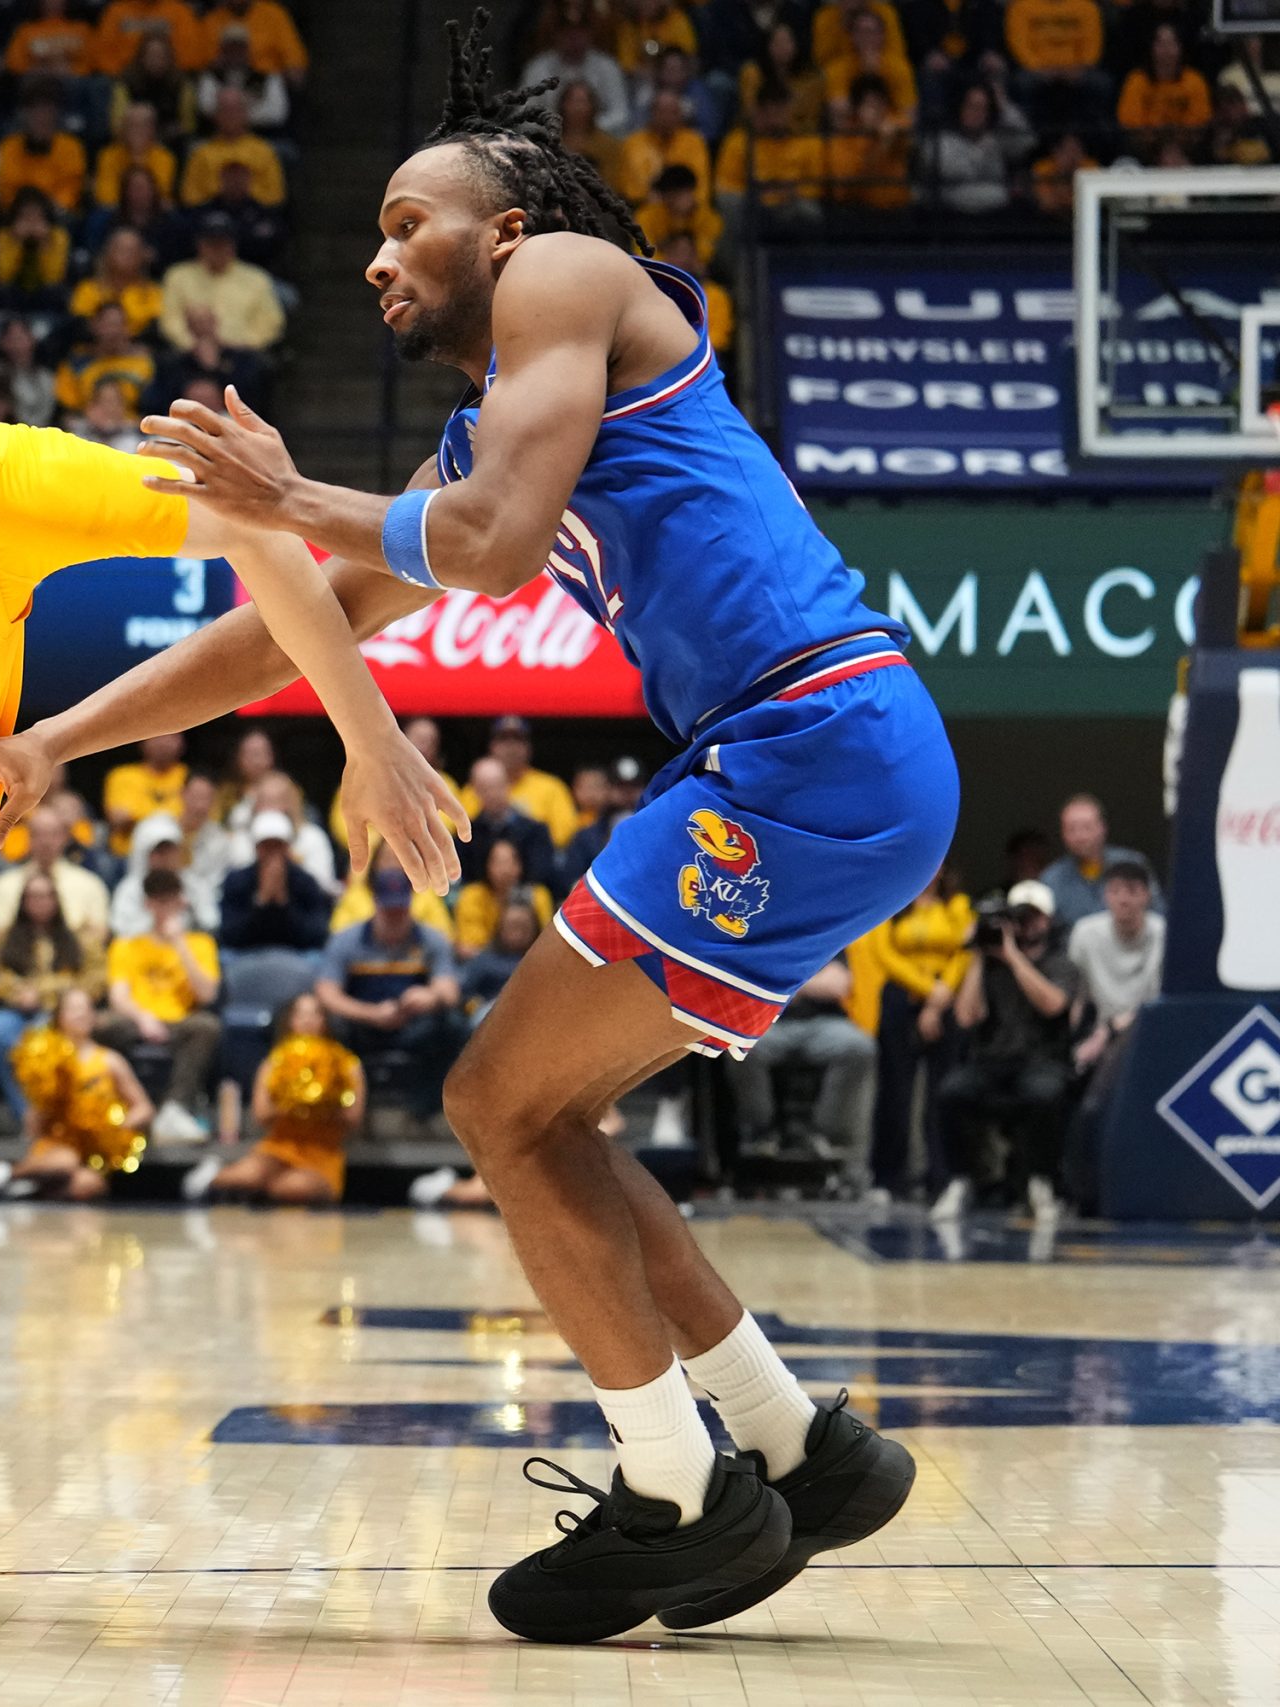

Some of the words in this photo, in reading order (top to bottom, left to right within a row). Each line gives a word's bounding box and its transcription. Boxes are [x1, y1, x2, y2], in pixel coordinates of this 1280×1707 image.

[784, 334, 1047, 364] CHRYSLER
[787, 374, 1059, 410] FORD
[709, 876, 742, 902] KU
